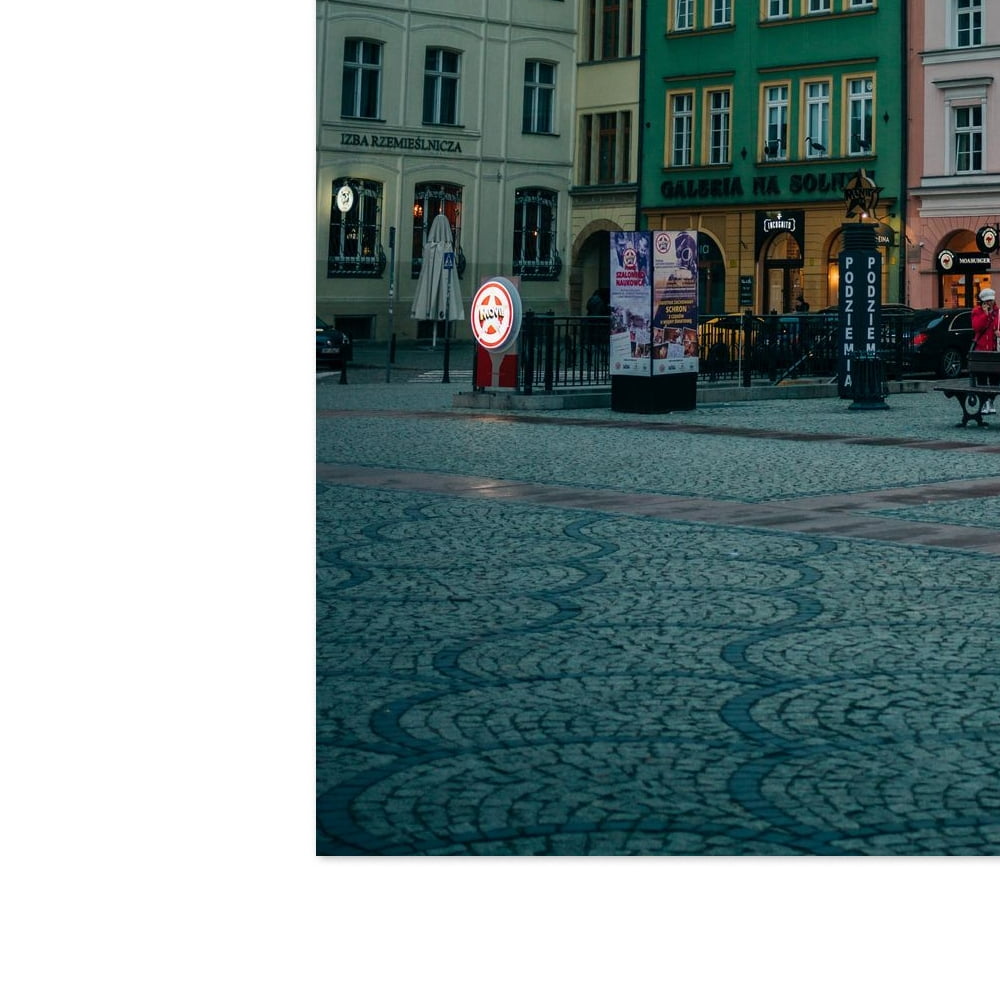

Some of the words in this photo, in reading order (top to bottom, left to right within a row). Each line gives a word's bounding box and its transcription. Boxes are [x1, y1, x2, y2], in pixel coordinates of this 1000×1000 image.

[341, 133, 369, 146] IZBA
[371, 135, 462, 153] RZEMIEŚLNICZA
[660, 177, 744, 199] GALERIA
[752, 174, 780, 196] NA
[665, 304, 687, 313] SCHRON
[866, 256, 876, 355] PODZIEM
[844, 256, 854, 387] PODZIEMIA
